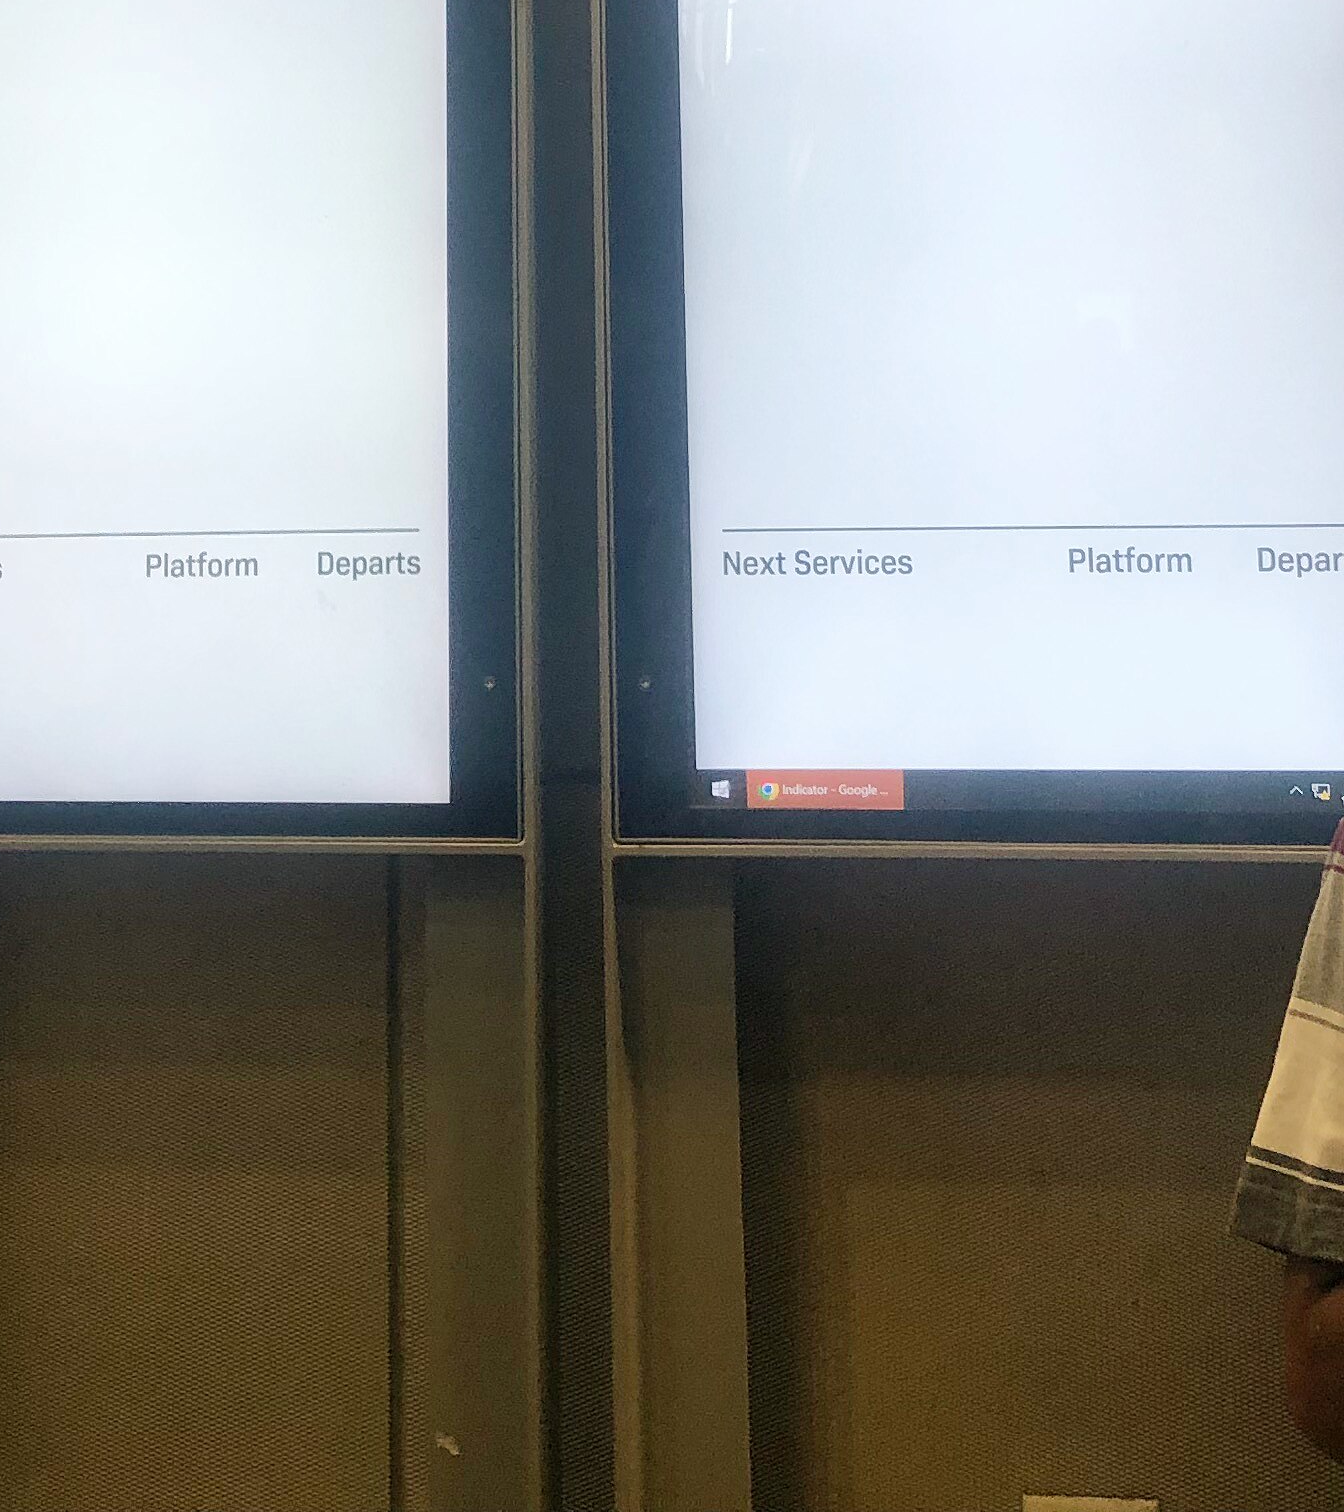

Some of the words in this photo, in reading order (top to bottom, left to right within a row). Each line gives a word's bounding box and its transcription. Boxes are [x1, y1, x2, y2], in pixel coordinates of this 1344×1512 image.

[145, 551, 259, 579] Platform
[317, 551, 421, 581] Departs
[722, 550, 786, 576] Next
[794, 548, 913, 576] Services
[1068, 546, 1193, 574] Platform
[782, 783, 828, 796] Indicator
[838, 783, 878, 798] Google
